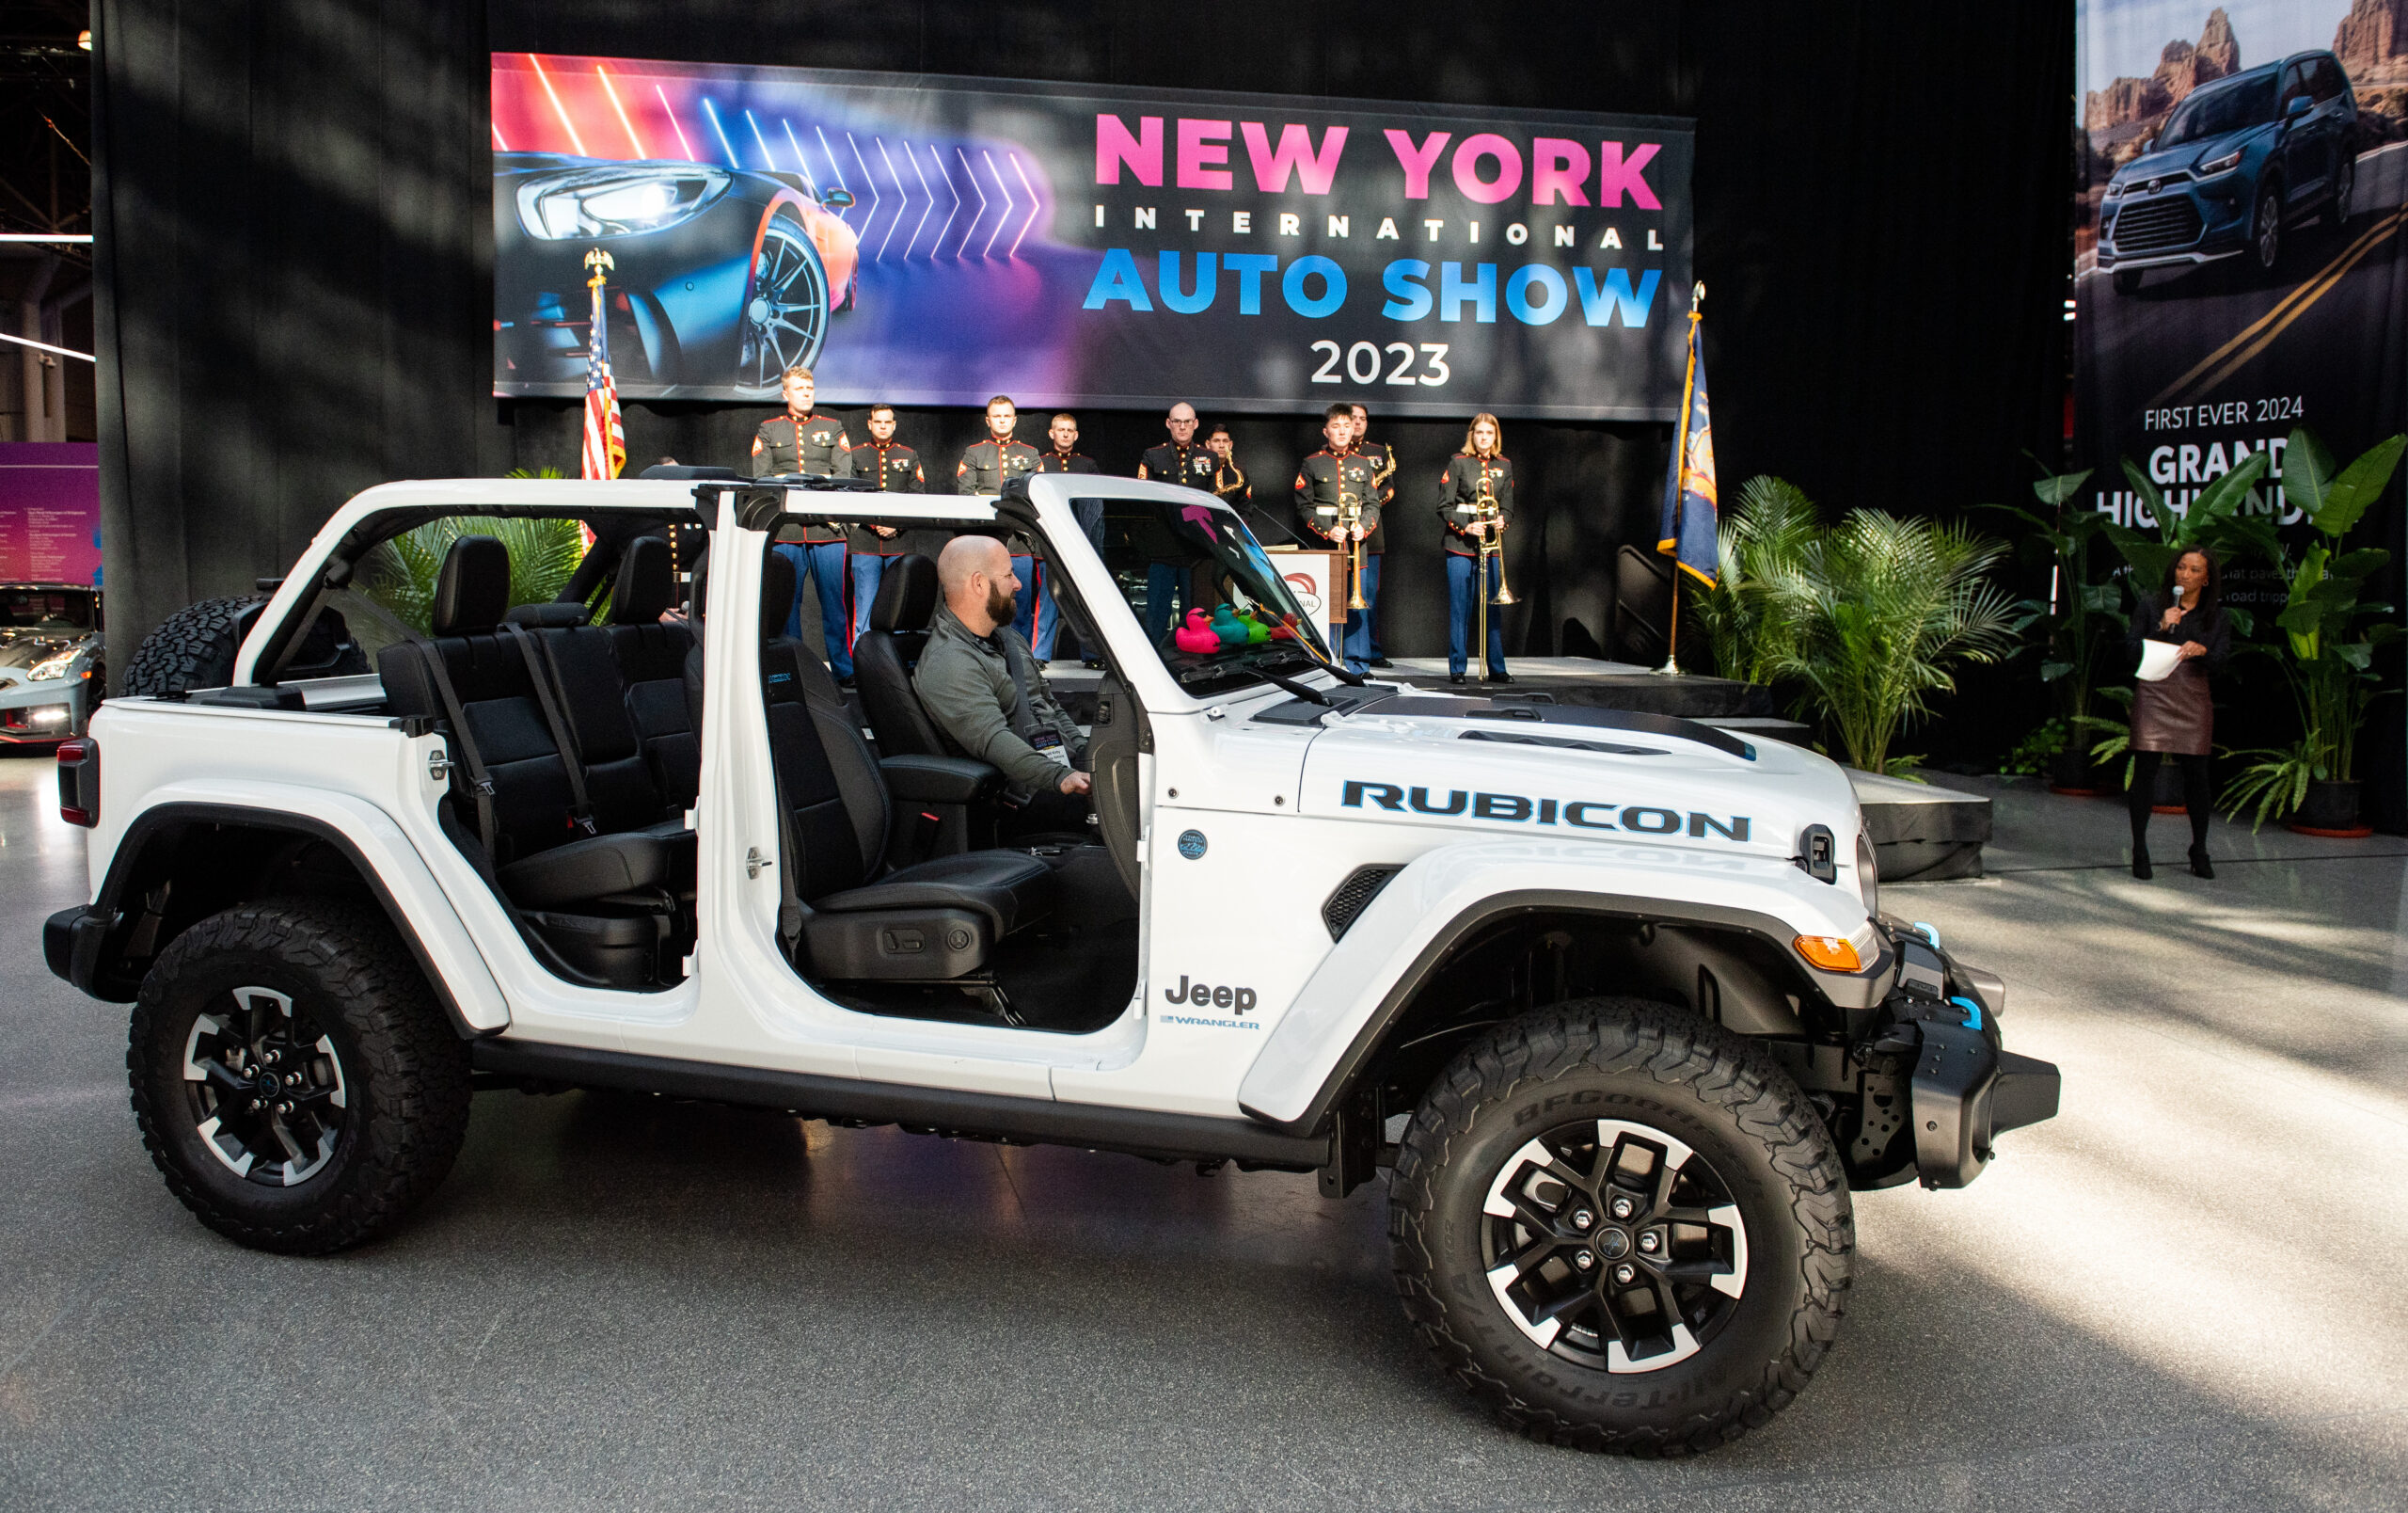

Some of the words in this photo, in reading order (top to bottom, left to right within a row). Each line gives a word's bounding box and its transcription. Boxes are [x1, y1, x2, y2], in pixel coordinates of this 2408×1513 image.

[1095, 114, 1349, 195] NEW
[1383, 129, 1663, 210] YORK
[1095, 205, 1664, 250] INTERNATIONAL
[1083, 248, 1348, 318] AUTO
[1382, 259, 1662, 327] SHOW
[1310, 340, 1450, 386] 2023
[2145, 406, 2194, 431] FIRST
[2197, 401, 2249, 426] EVER
[2256, 395, 2304, 422] 2024
[1341, 780, 1751, 842] RUBICON
[1165, 975, 1257, 1015] Jeep
[1175, 1015, 1259, 1029] WRANGLER
